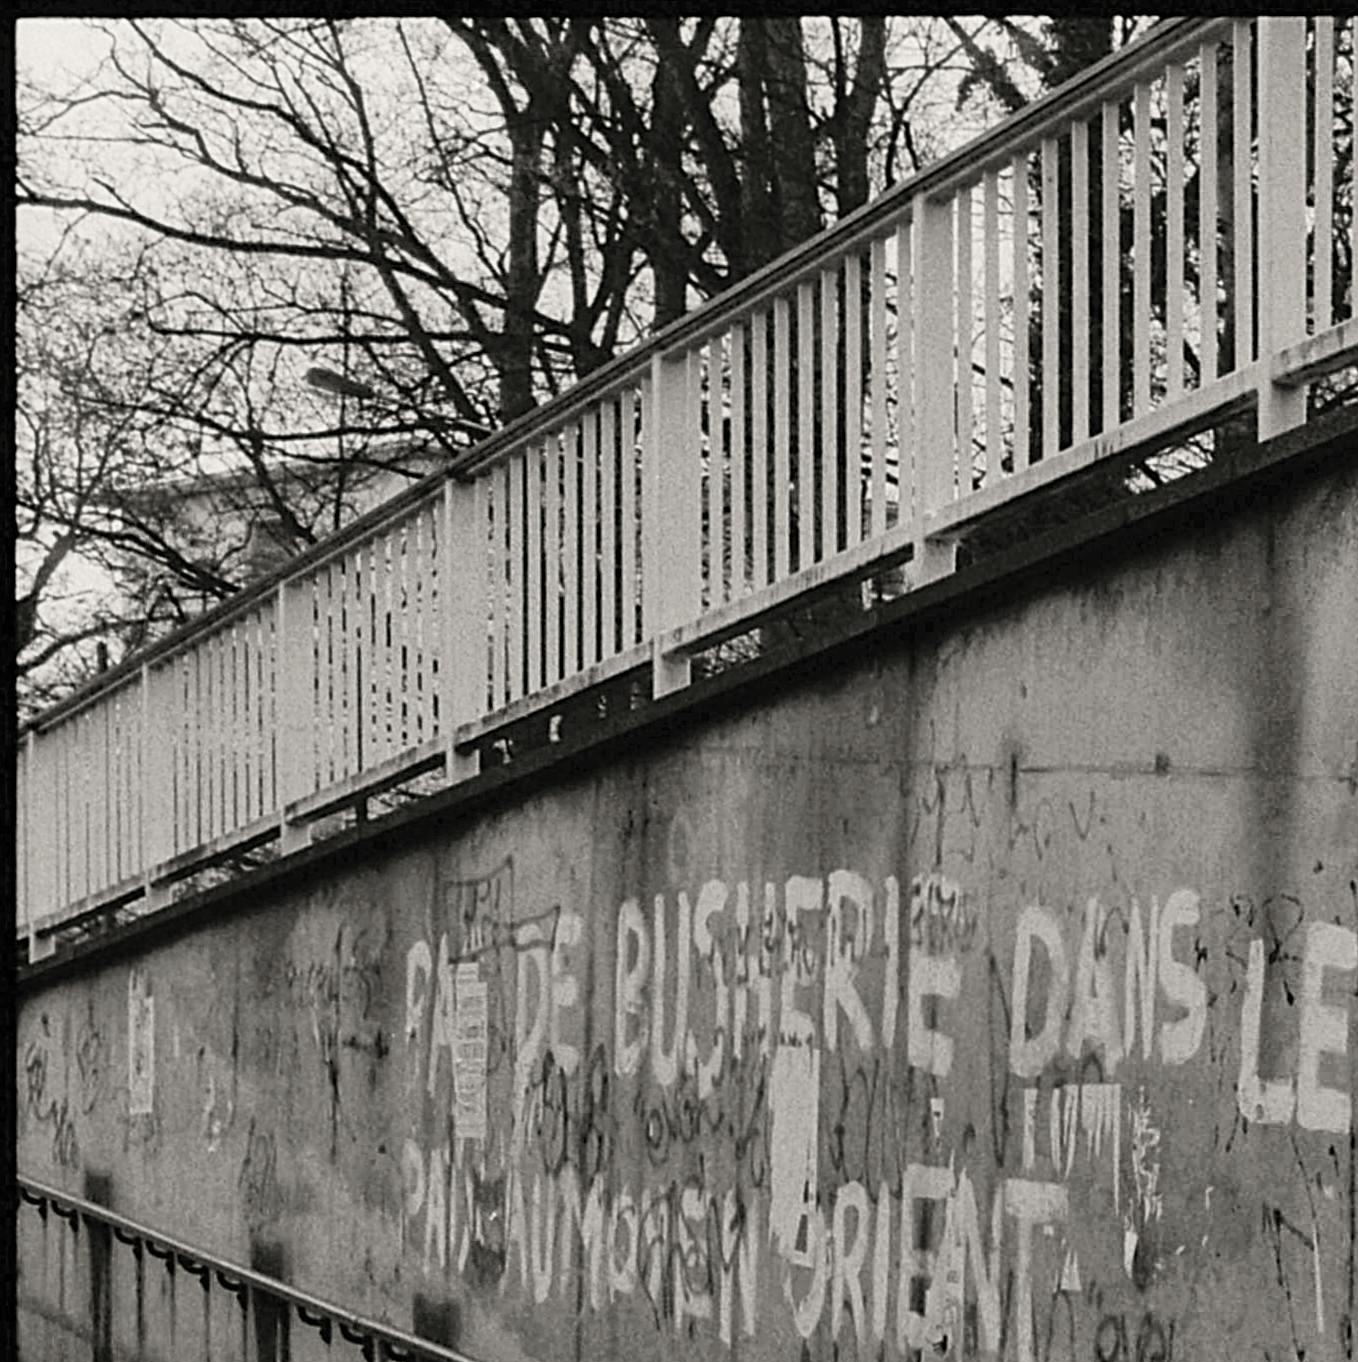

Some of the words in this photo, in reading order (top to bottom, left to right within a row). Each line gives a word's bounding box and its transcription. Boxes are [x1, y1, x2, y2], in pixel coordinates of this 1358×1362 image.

[512, 912, 583, 1092] DE
[614, 870, 963, 1100] BUSHERIE
[1010, 889, 1205, 1078] DANS
[1237, 921, 1358, 1133] LE
